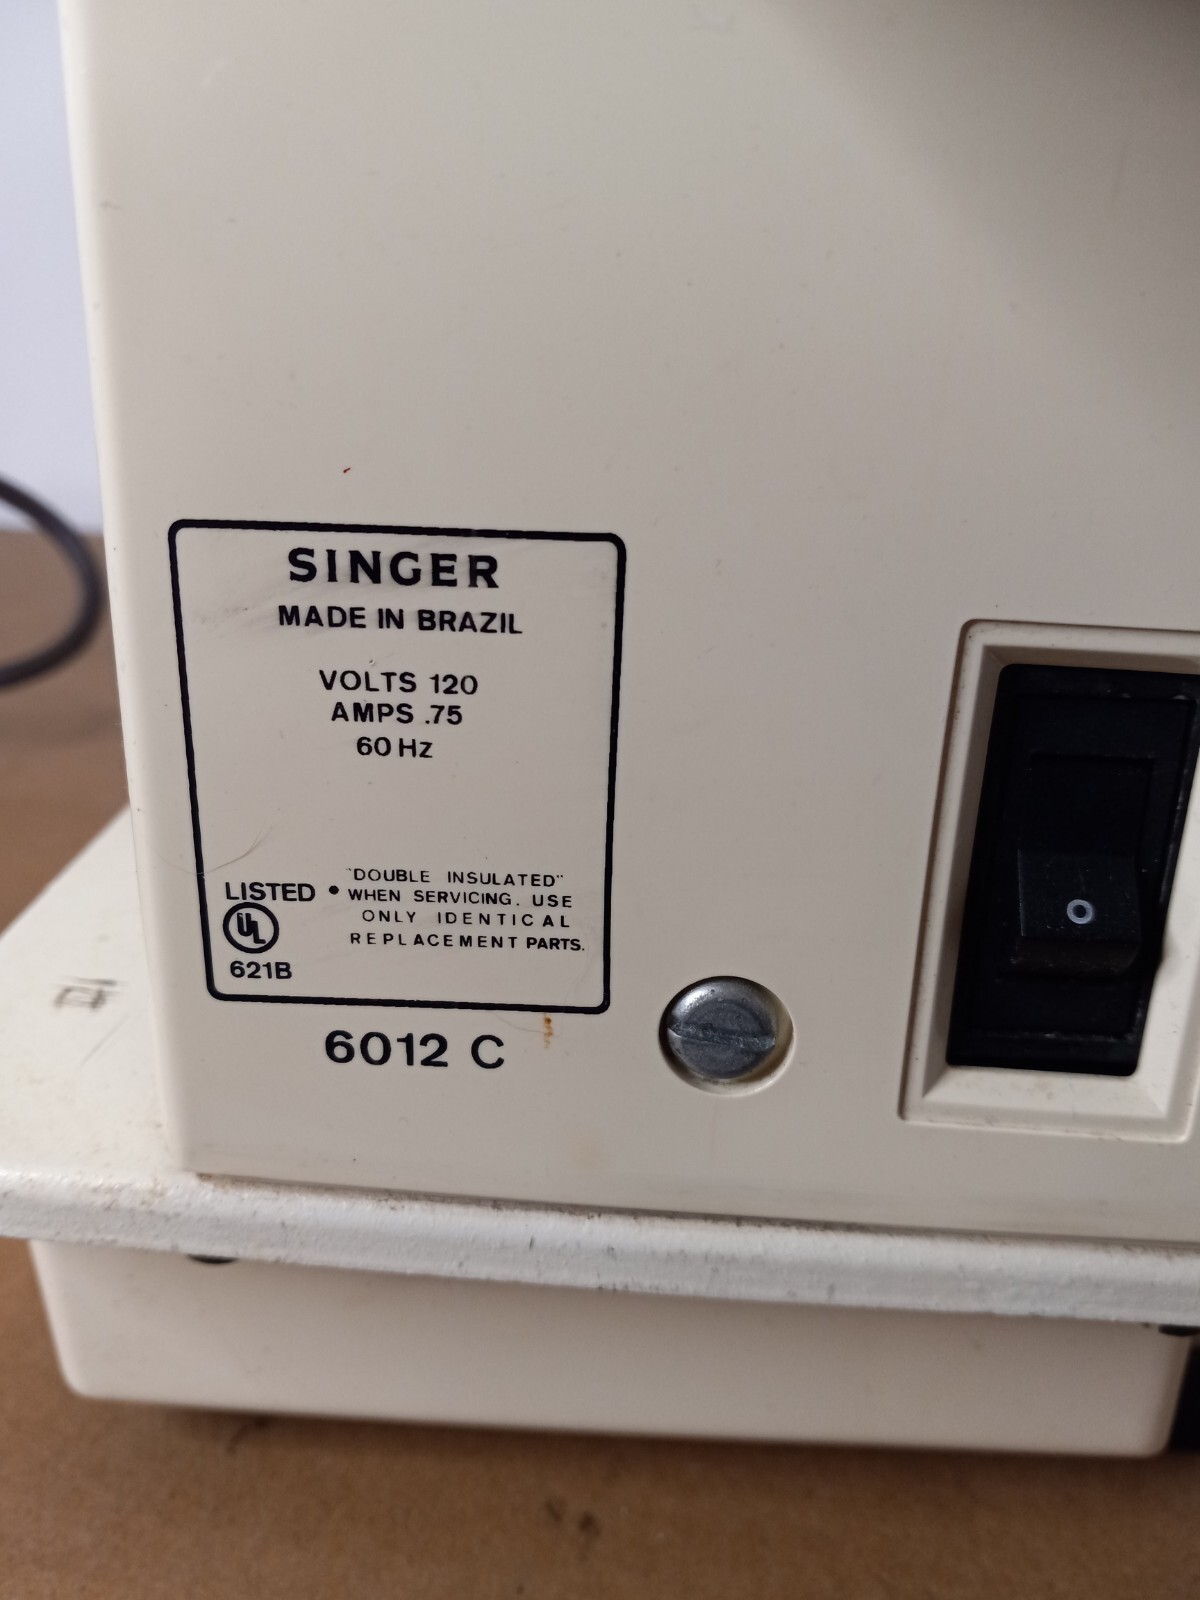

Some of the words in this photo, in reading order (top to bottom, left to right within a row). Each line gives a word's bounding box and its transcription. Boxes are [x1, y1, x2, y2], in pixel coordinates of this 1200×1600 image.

[287, 546, 500, 589] SINGER
[277, 604, 367, 629] MADE
[377, 607, 405, 630] IN
[416, 608, 523, 636] BRAZIL
[318, 669, 418, 694] VOLTS
[428, 673, 479, 696] 120
[330, 701, 415, 725] AMPS
[424, 704, 463, 726] .75
[356, 736, 392, 757] 60
[398, 737, 433, 759] Hz
[224, 881, 316, 903] LISTED
[347, 888, 402, 903] WHEN
[532, 893, 573, 908] USE
[361, 909, 416, 924] ONLY
[437, 911, 571, 928] IDENTICAL
[349, 932, 518, 949] REPLACEMENT
[526, 936, 586, 952] PARTS.
[229, 959, 293, 980] 621B
[324, 1029, 449, 1068] 6012
[470, 1034, 505, 1070] C
